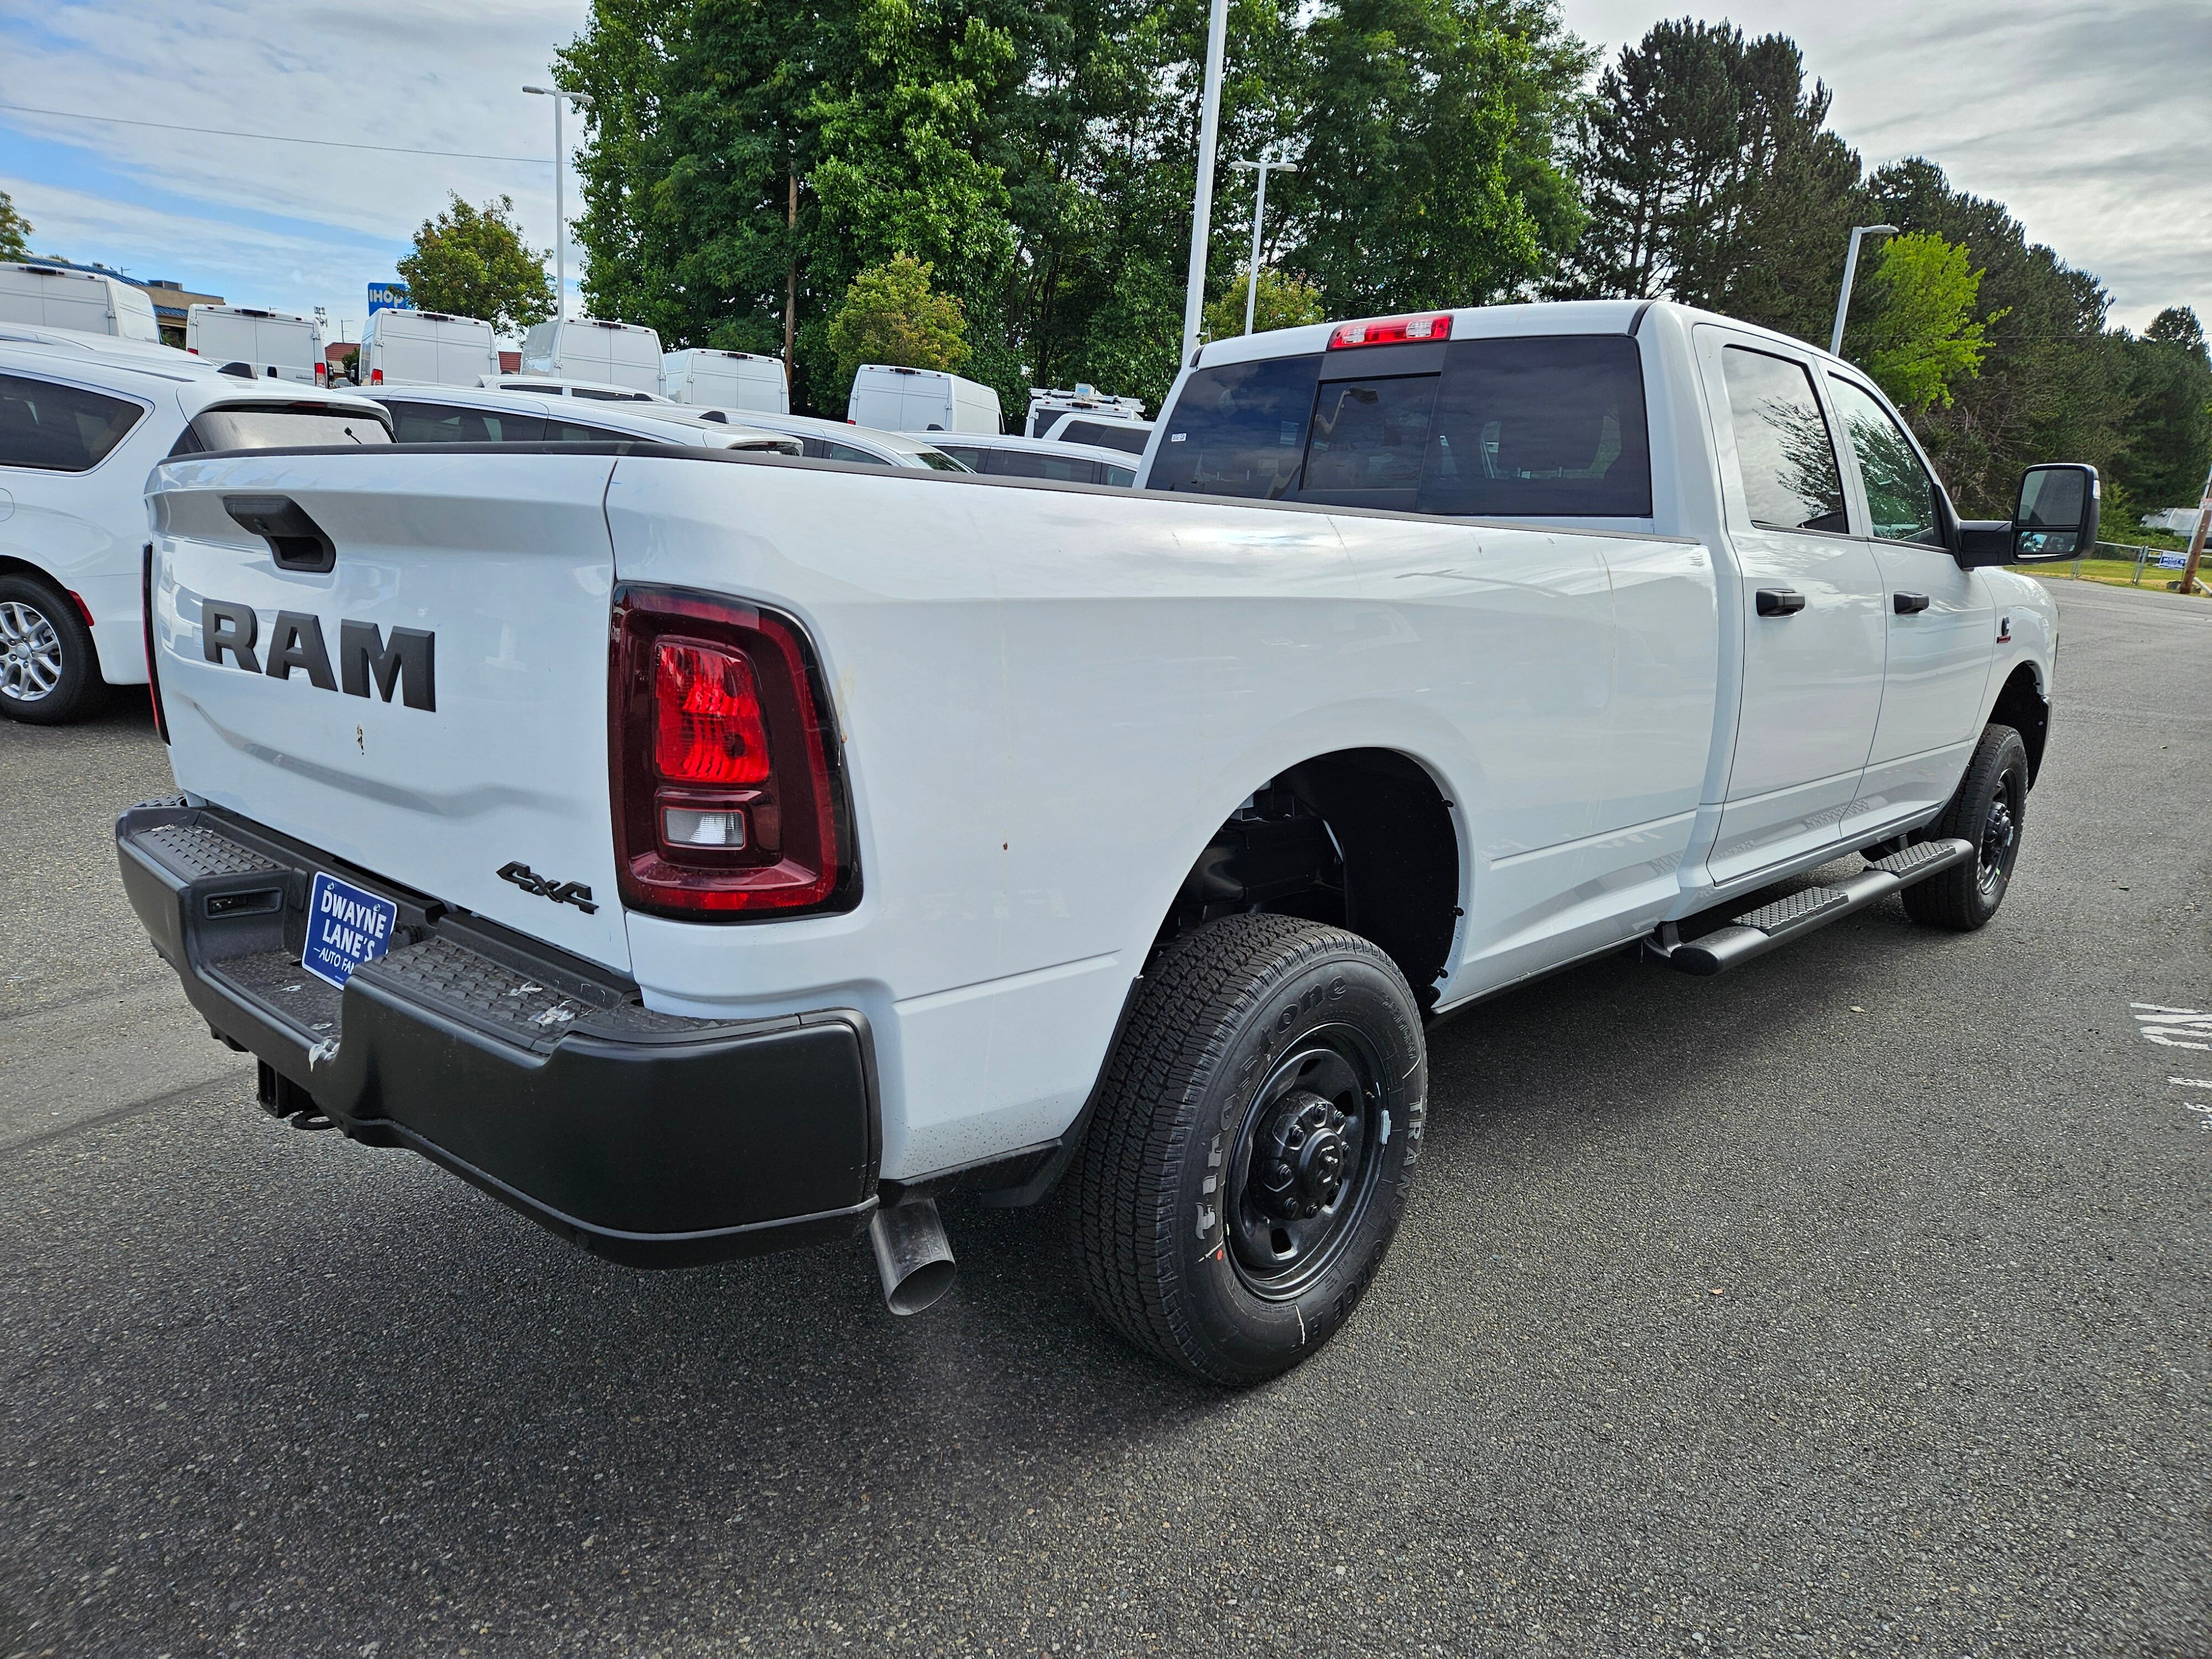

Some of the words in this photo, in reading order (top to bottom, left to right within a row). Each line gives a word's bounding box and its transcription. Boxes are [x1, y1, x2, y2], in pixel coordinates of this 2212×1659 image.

[202, 598, 436, 712] RAM
[321, 889, 387, 939] DWAYNE
[322, 919, 375, 962] LANE'S
